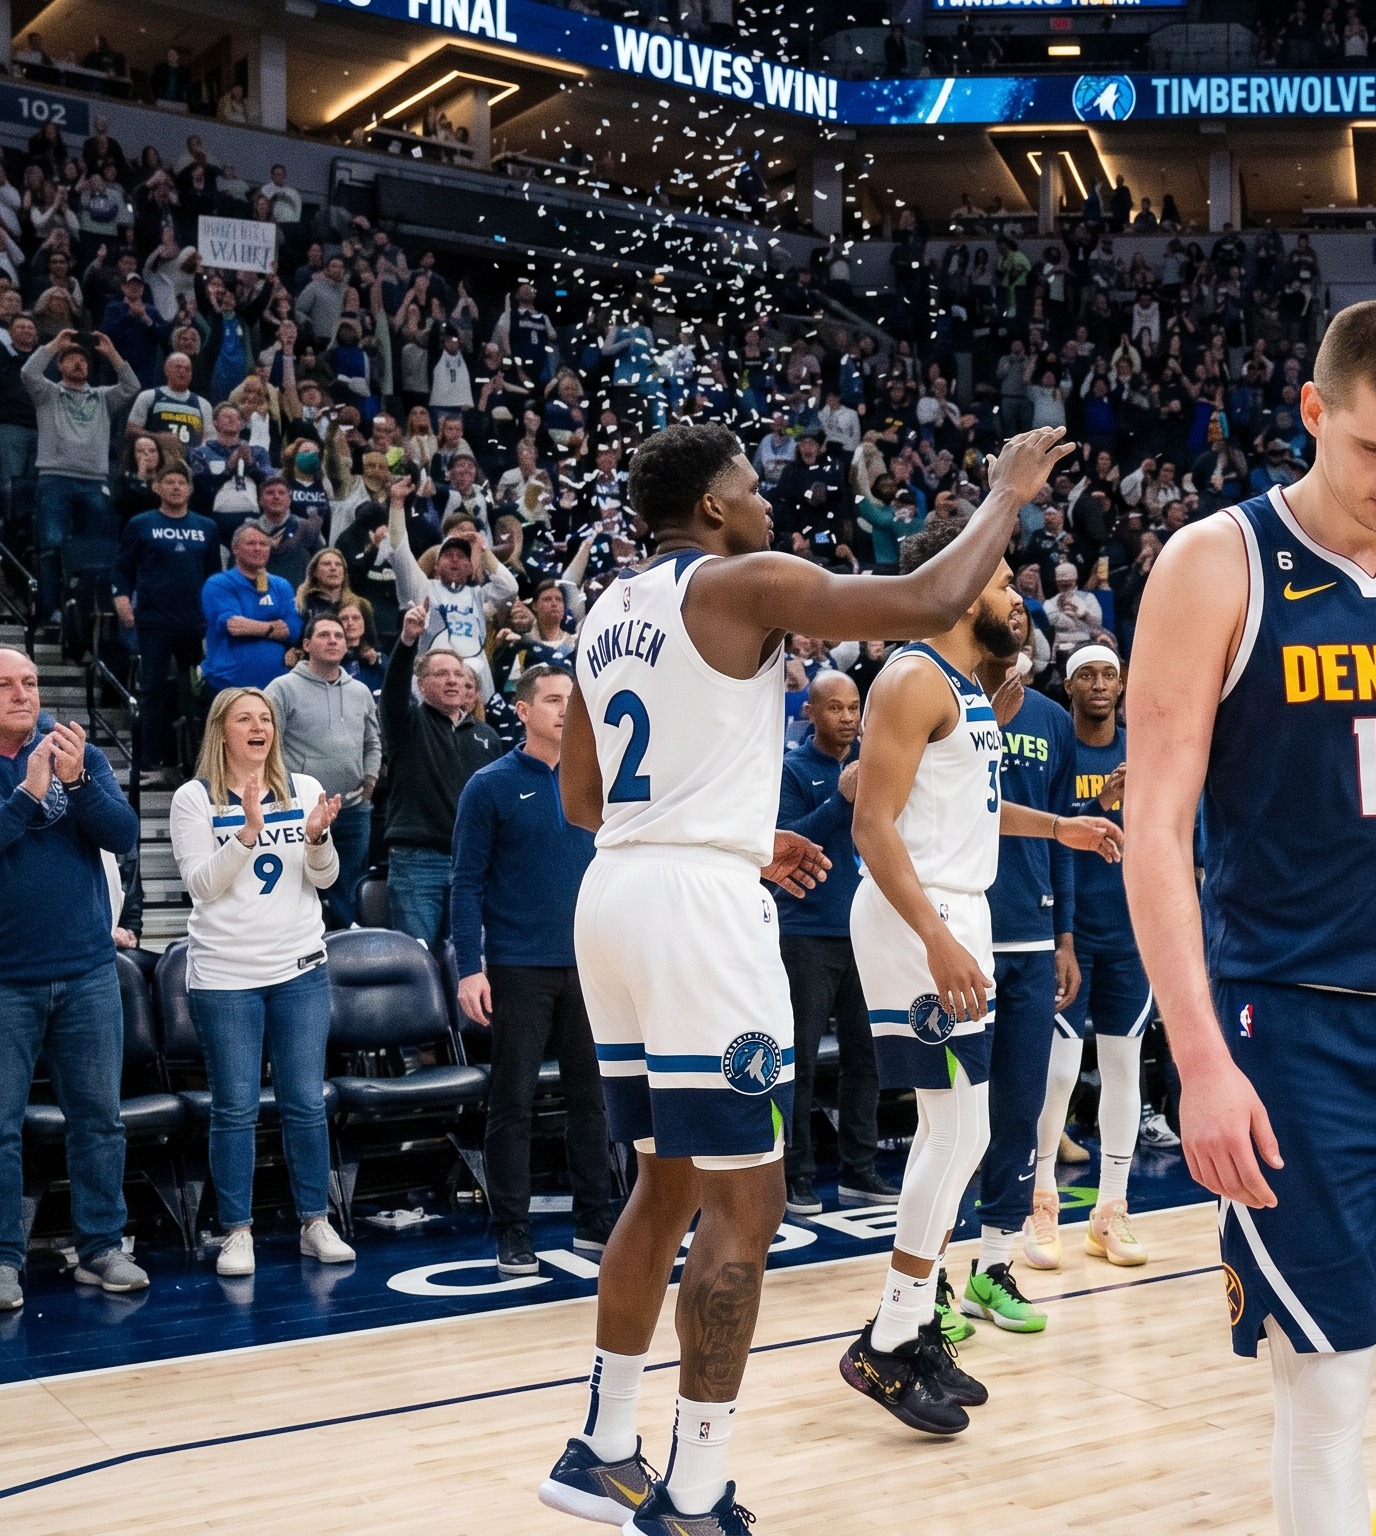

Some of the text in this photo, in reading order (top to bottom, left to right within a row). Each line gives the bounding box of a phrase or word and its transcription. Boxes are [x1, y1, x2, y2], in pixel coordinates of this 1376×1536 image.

[613, 25, 838, 119] WOLVES WIN!
[18, 97, 67, 125] 102
[152, 527, 205, 542] WOLVES
[1277, 551, 1293, 570] 6
[603, 689, 651, 804] 2
[253, 852, 284, 896] 9
